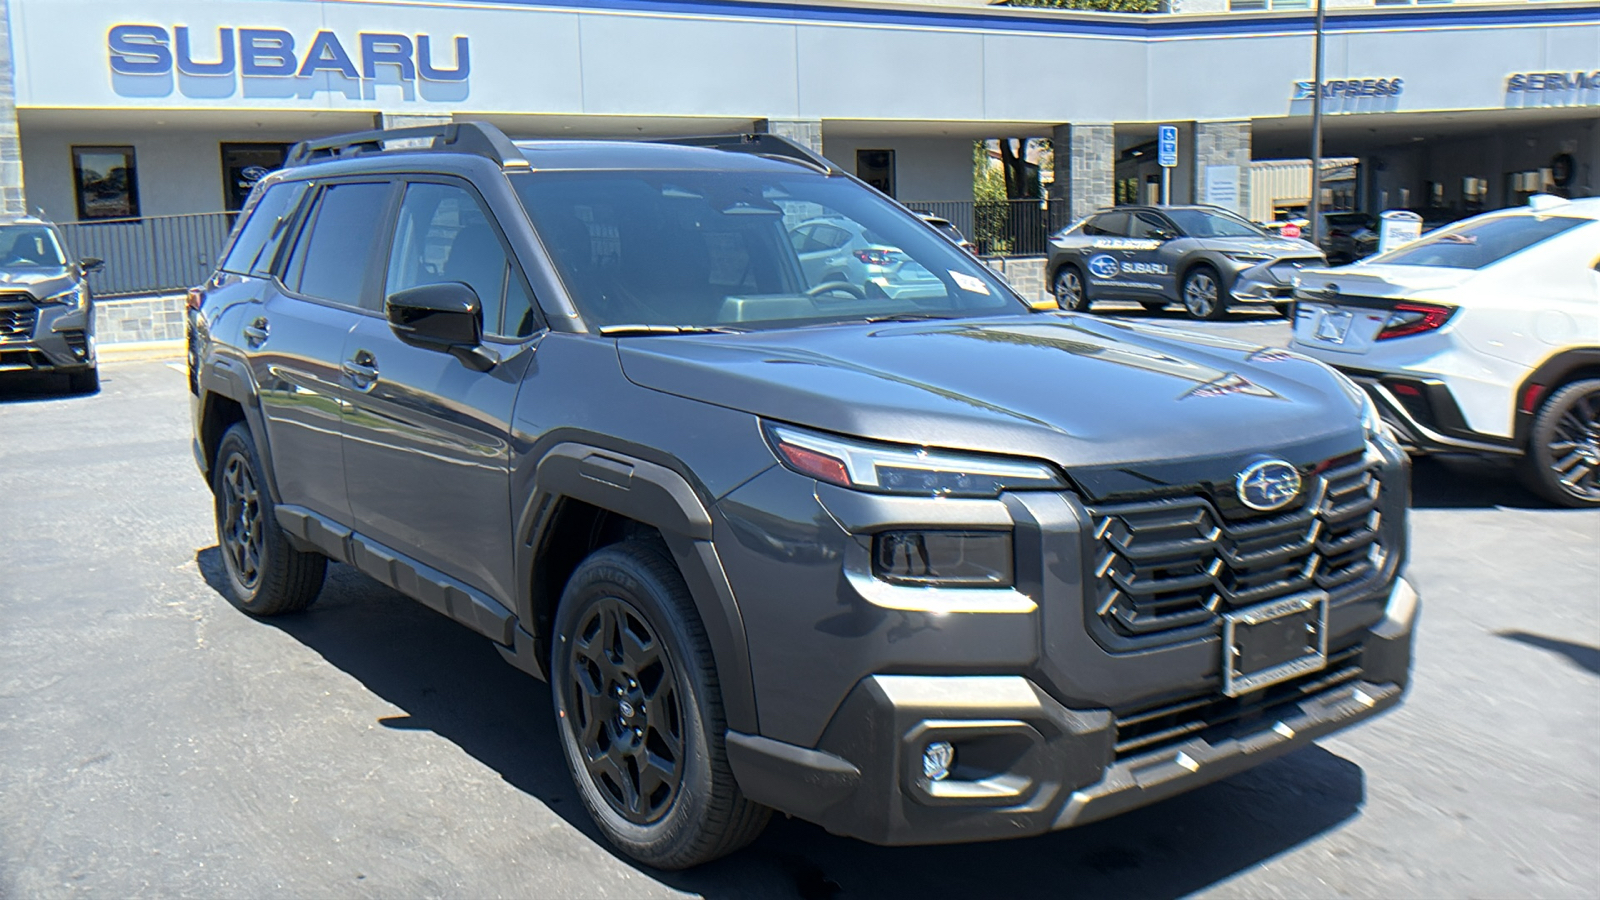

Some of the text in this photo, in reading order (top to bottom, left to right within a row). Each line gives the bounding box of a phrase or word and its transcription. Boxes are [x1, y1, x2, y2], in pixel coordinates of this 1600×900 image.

[108, 25, 470, 82] SUBARU
[1294, 77, 1404, 99] EXPRESS
[1121, 262, 1168, 275] SUBARU
